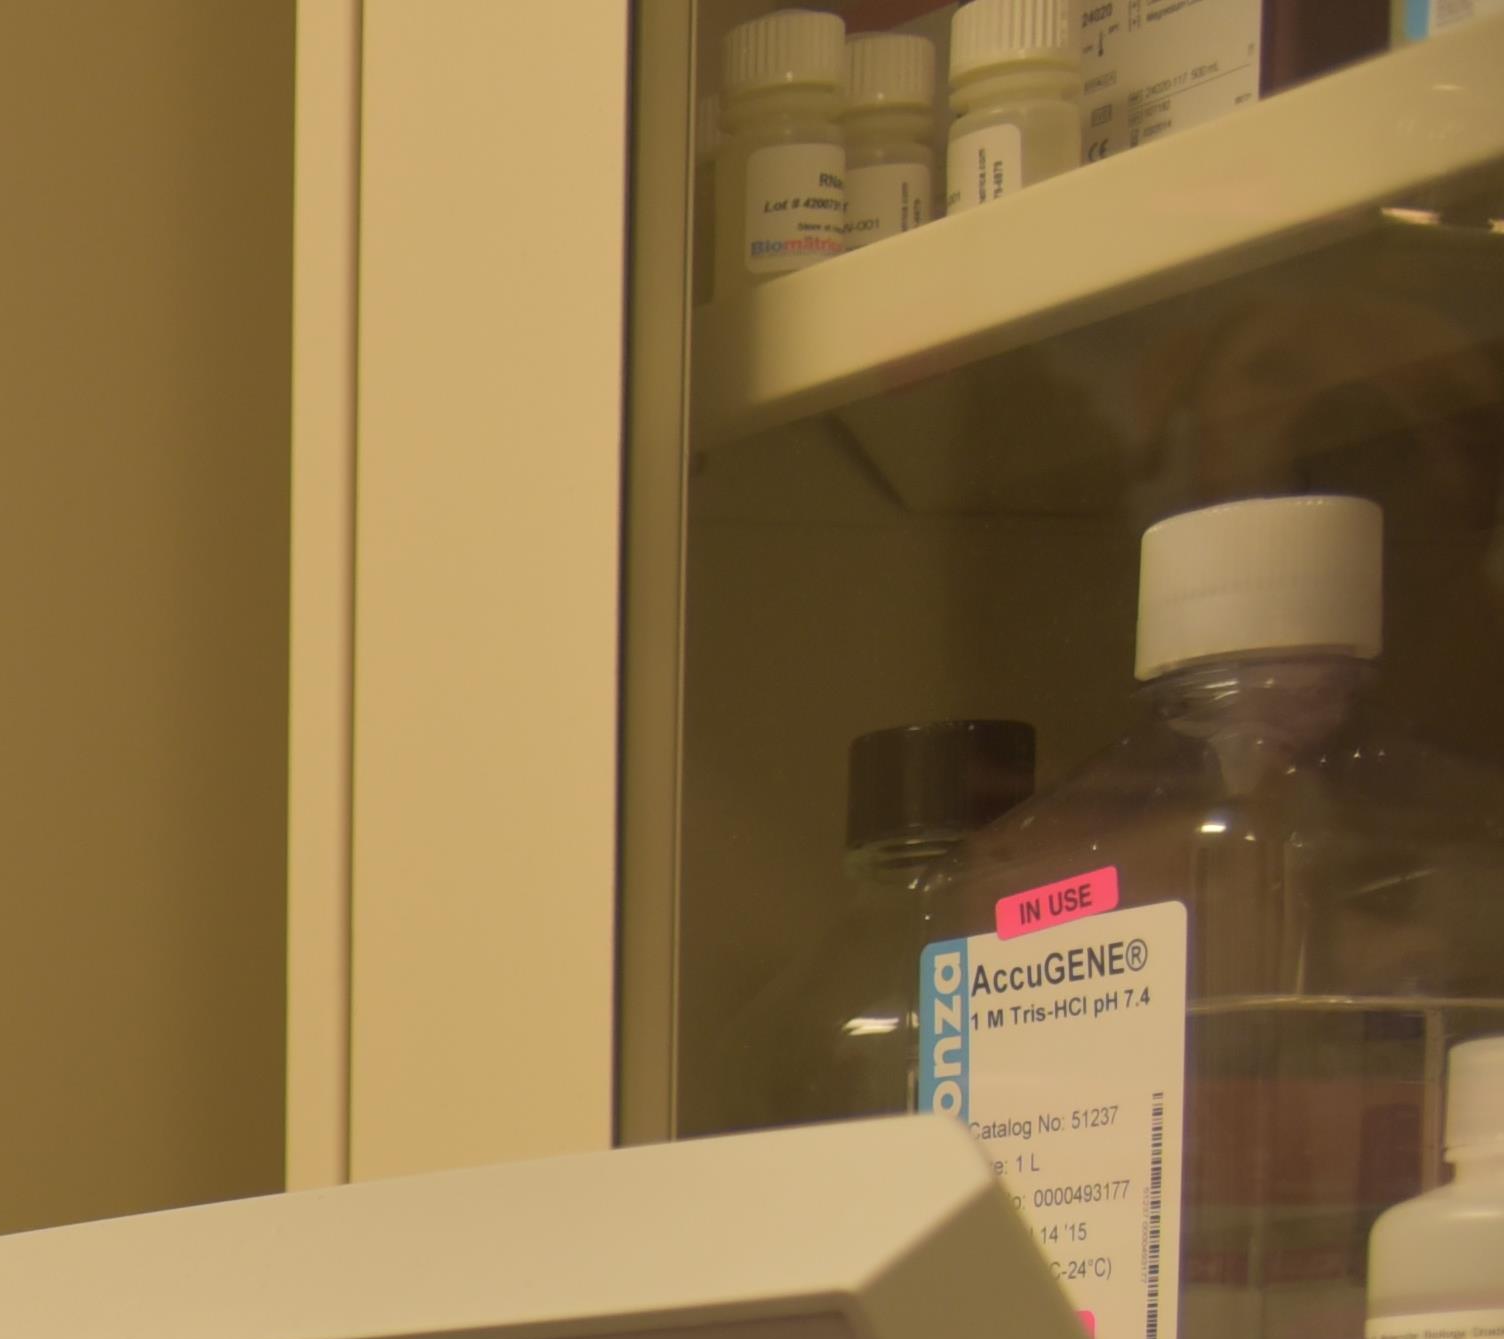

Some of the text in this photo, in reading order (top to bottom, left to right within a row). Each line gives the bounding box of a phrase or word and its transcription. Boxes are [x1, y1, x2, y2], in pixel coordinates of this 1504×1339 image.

[1019, 884, 1092, 925] IN USE
[971, 987, 1150, 1030] 1 M Tris-HCl pH 7.4
[933, 952, 962, 1119] onza
[1039, 1114, 1064, 1133] No:
[1071, 1105, 1119, 1130] 51237
[1016, 1155, 1023, 1172] 1
[1031, 1153, 1040, 1172] L
[1034, 1180, 1130, 1209] 0000493177
[1041, 1222, 1087, 1244] 14 '15
